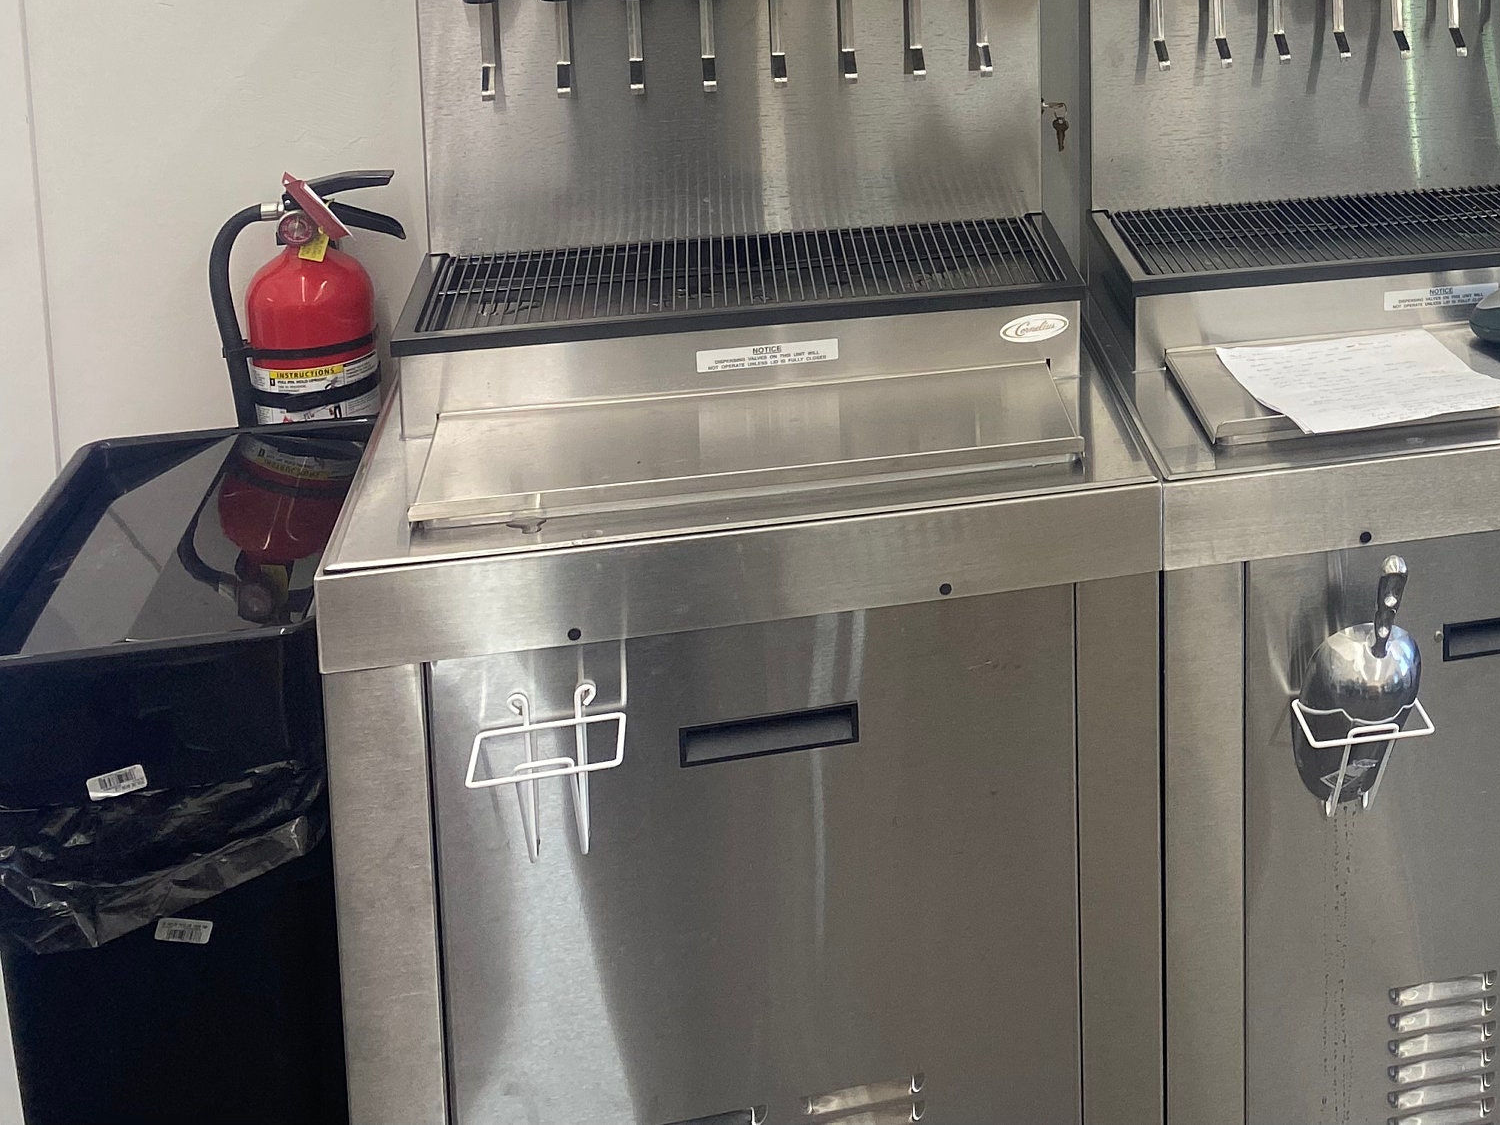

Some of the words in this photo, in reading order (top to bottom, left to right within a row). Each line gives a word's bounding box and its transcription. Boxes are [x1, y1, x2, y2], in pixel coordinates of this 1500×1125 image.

[1430, 287, 1453, 295] NOTICE
[752, 345, 782, 355] NOTICE
[276, 367, 335, 379] INSTRUCTIONS
